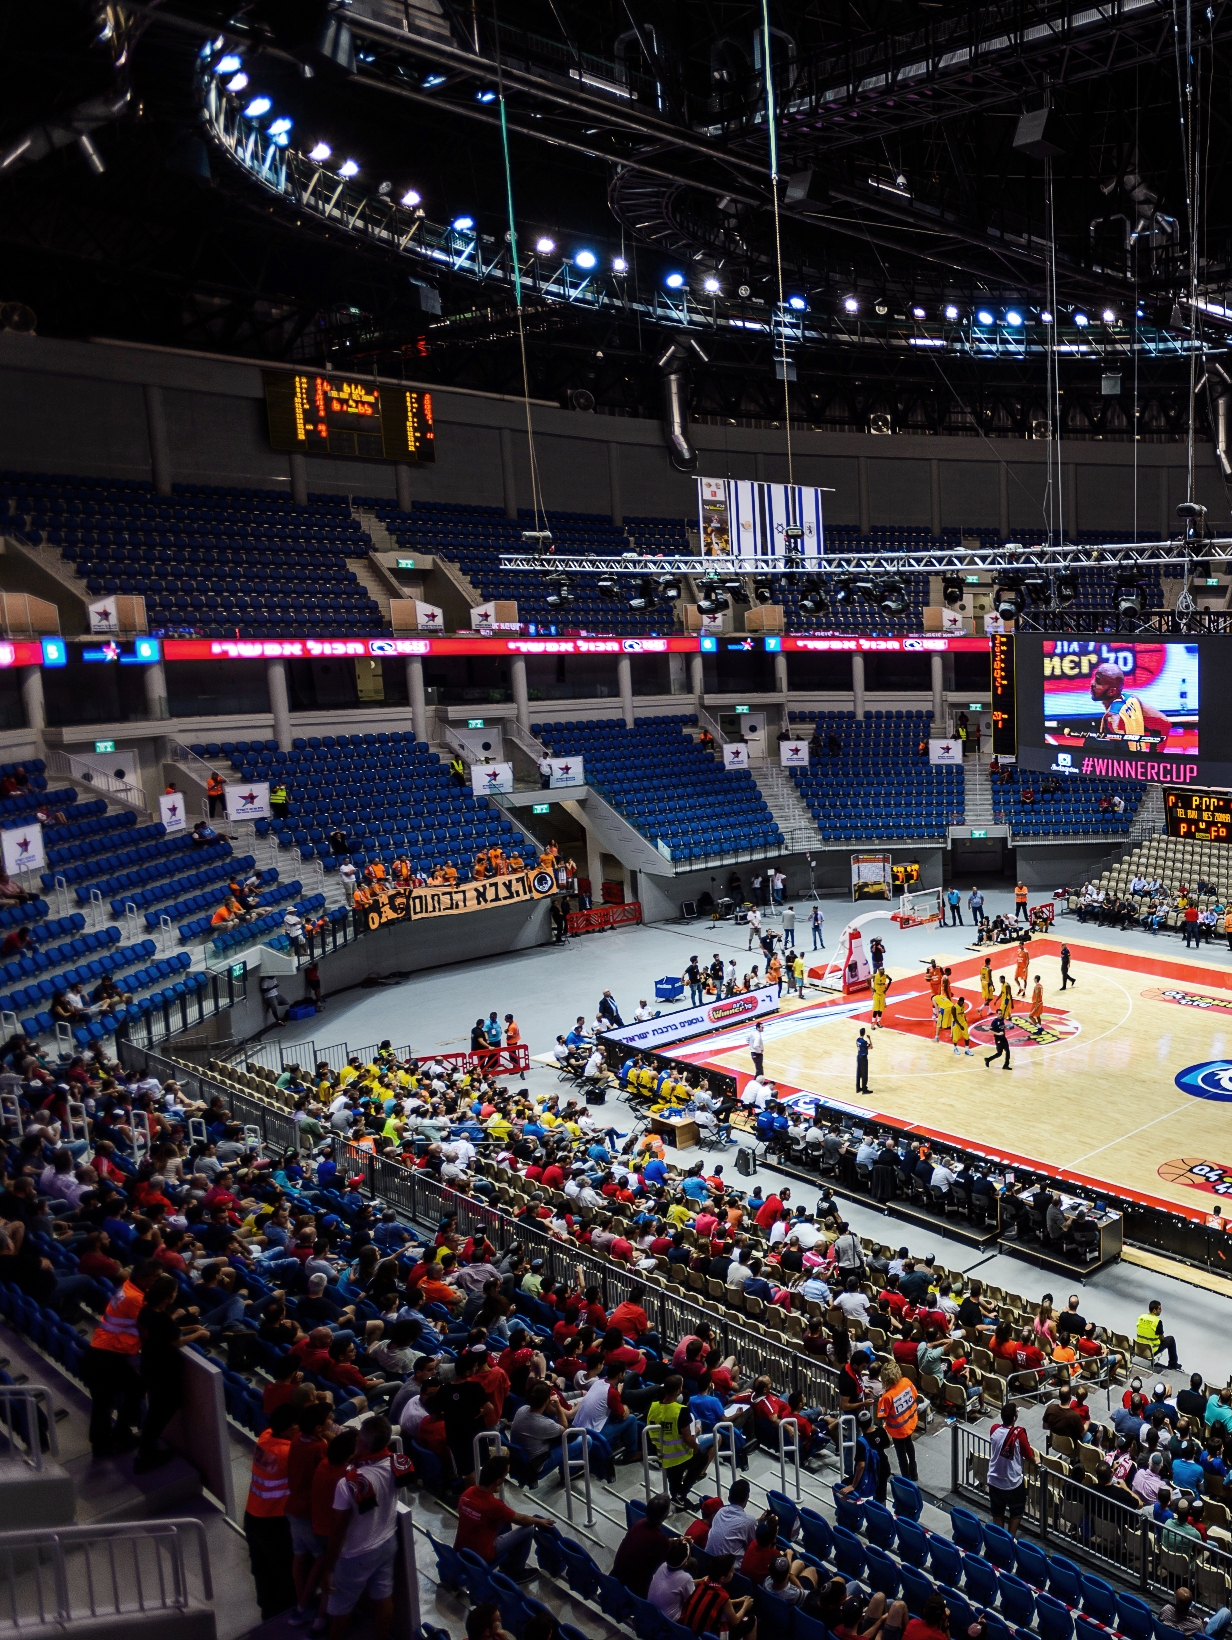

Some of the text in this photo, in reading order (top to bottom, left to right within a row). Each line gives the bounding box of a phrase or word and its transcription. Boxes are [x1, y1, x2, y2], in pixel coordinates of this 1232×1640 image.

[212, 642, 303, 657] אפשרי
[507, 640, 574, 652] אפשרי
[769, 639, 776, 649] 7
[795, 639, 857, 650] אפשרי
[1081, 756, 1198, 783] #WINNERCUP
[1176, 808, 1186, 818] TEL
[473, 877, 527, 905] הצבא
[413, 893, 466, 915] הכתום
[712, 1004, 745, 1020] Winner
[652, 1023, 679, 1038] ברכבת
[1192, 1165, 1223, 1182] סל
